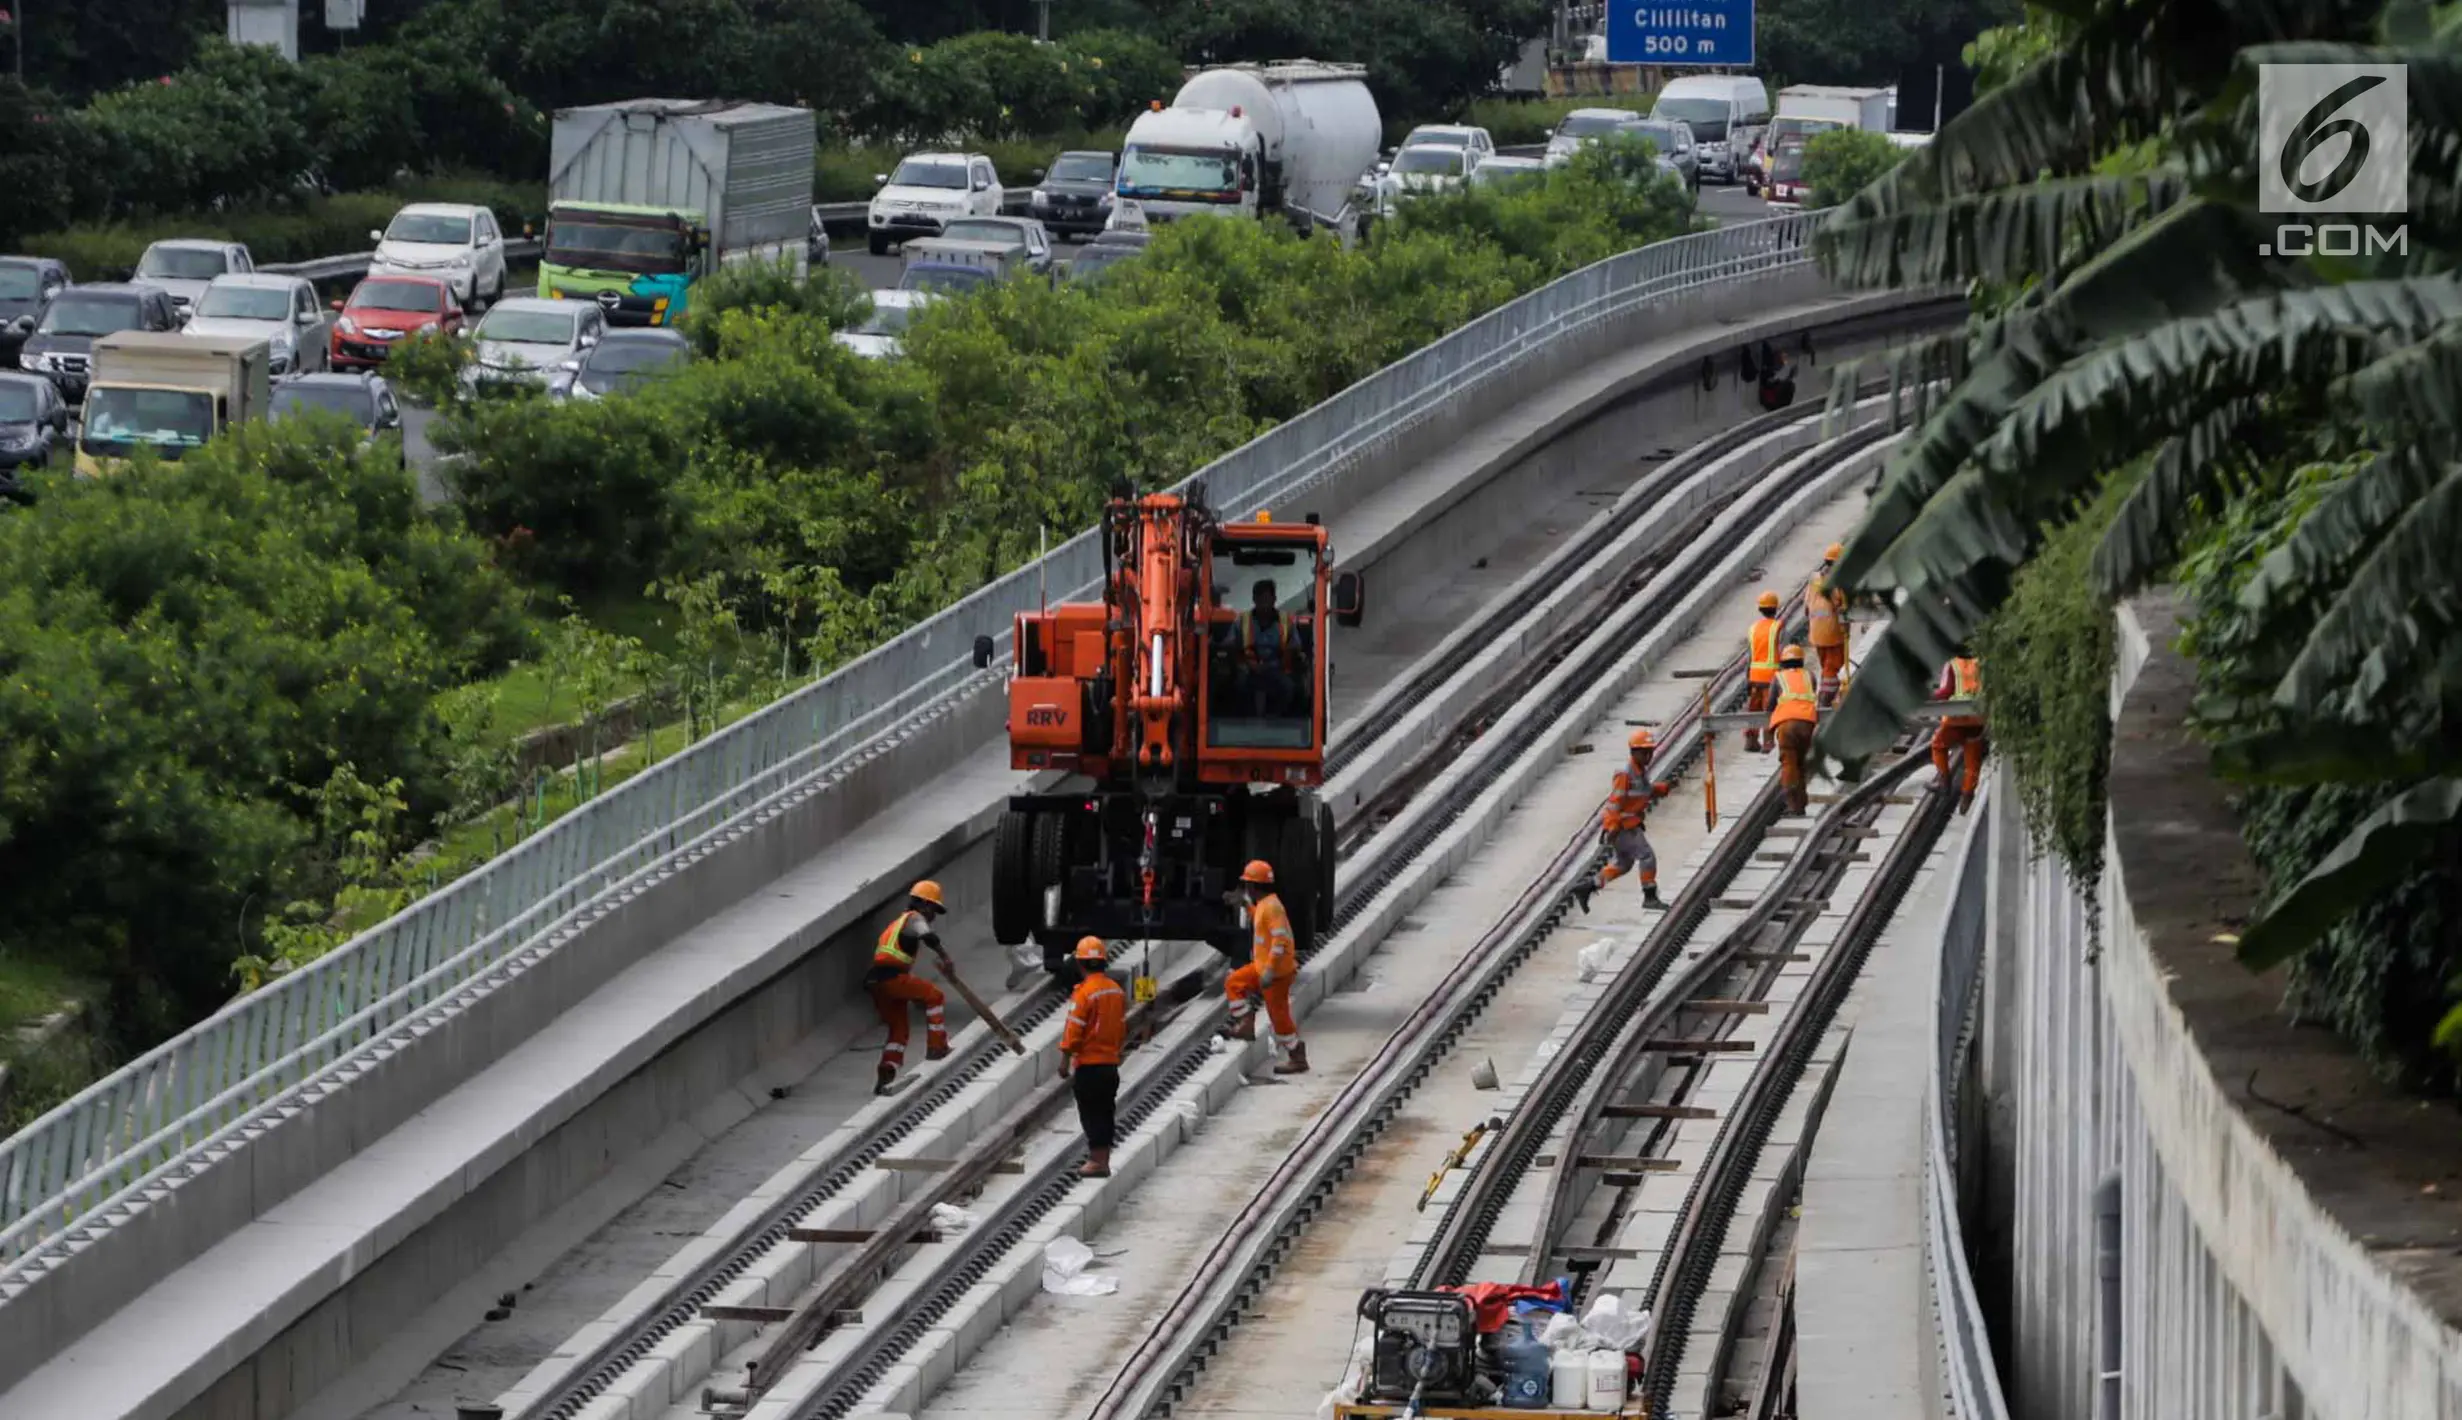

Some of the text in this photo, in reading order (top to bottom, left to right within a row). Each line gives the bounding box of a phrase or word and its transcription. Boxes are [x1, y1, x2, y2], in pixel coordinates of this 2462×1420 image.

[1645, 35, 1715, 54] 500 m
[1026, 709, 1068, 727] RRV
